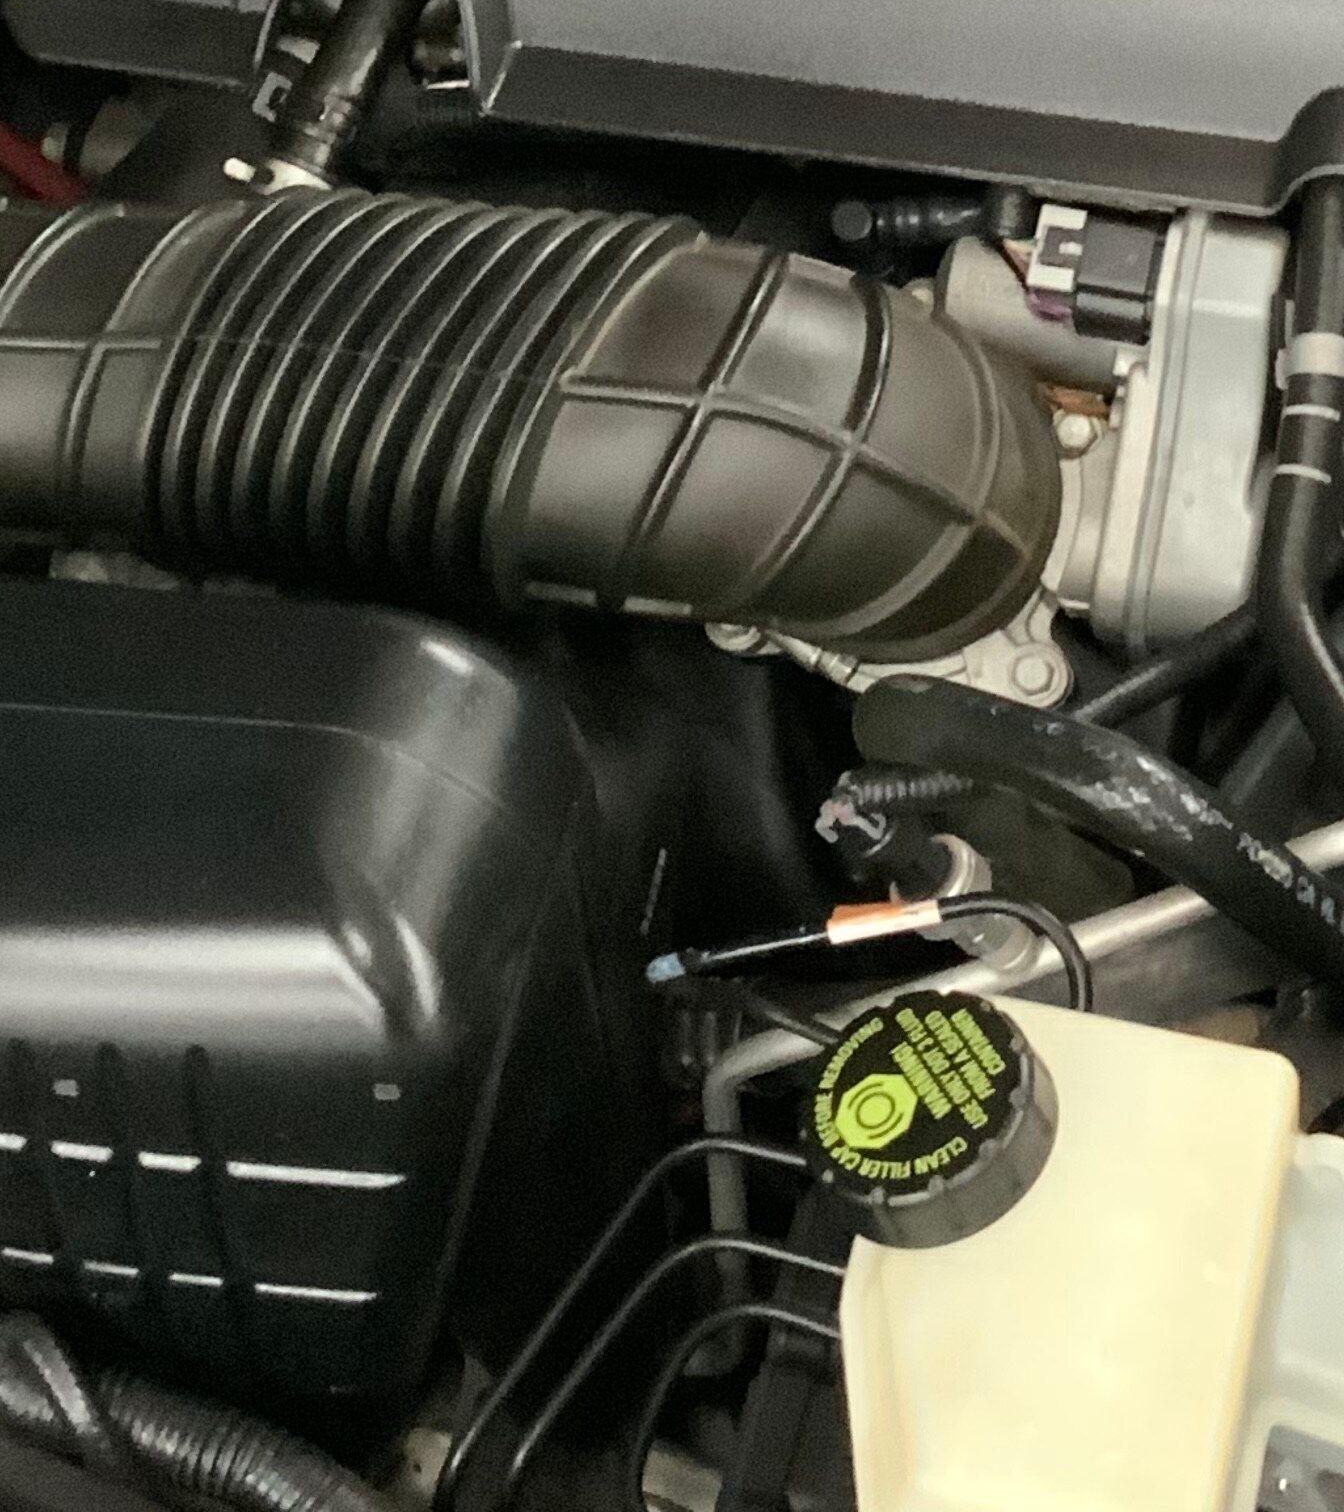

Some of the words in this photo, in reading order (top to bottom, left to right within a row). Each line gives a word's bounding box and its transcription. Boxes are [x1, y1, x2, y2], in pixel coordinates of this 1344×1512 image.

[895, 1008, 927, 1043] FLUID
[925, 1010, 964, 1055] SEALED
[951, 1008, 1006, 1076] CONTAINER
[818, 1017, 884, 1089] REMOVING
[916, 1038, 934, 1051] 3
[922, 1047, 950, 1075] DOT
[954, 1049, 971, 1063] A
[939, 1070, 971, 1104] ONLY
[959, 1059, 996, 1100] FROM
[814, 1091, 840, 1148] BEFORE
[959, 1099, 988, 1130] USE
[830, 1145, 861, 1170] CAP
[859, 1159, 910, 1179] FILLER
[914, 1137, 968, 1174] CLEAN
